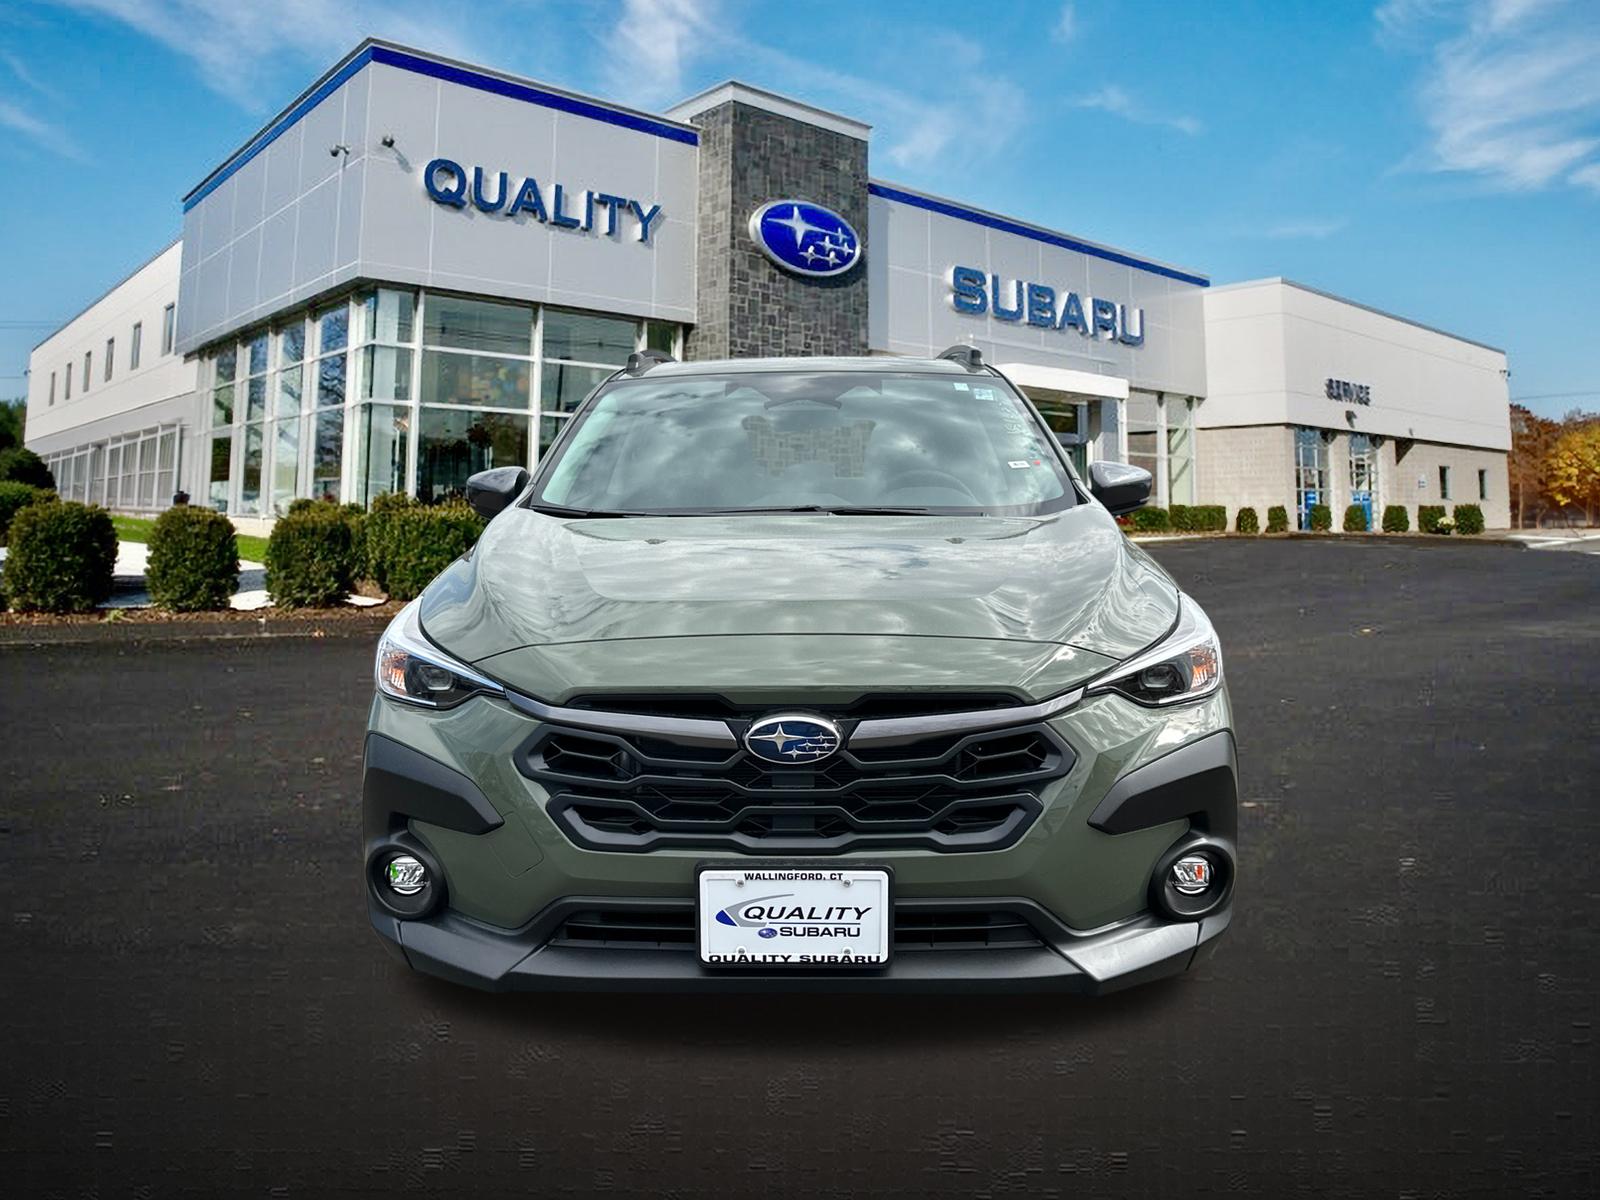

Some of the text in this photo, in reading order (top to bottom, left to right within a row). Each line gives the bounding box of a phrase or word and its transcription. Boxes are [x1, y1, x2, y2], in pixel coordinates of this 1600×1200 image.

[423, 158, 662, 243] QUALITY
[949, 265, 1146, 346] SUBARU
[1325, 378, 1370, 406] SERVICE
[830, 872, 844, 881] CT
[743, 905, 873, 921] QUALITY
[779, 926, 861, 938] SUBARU
[708, 954, 881, 964] QUALITY SUBARU
